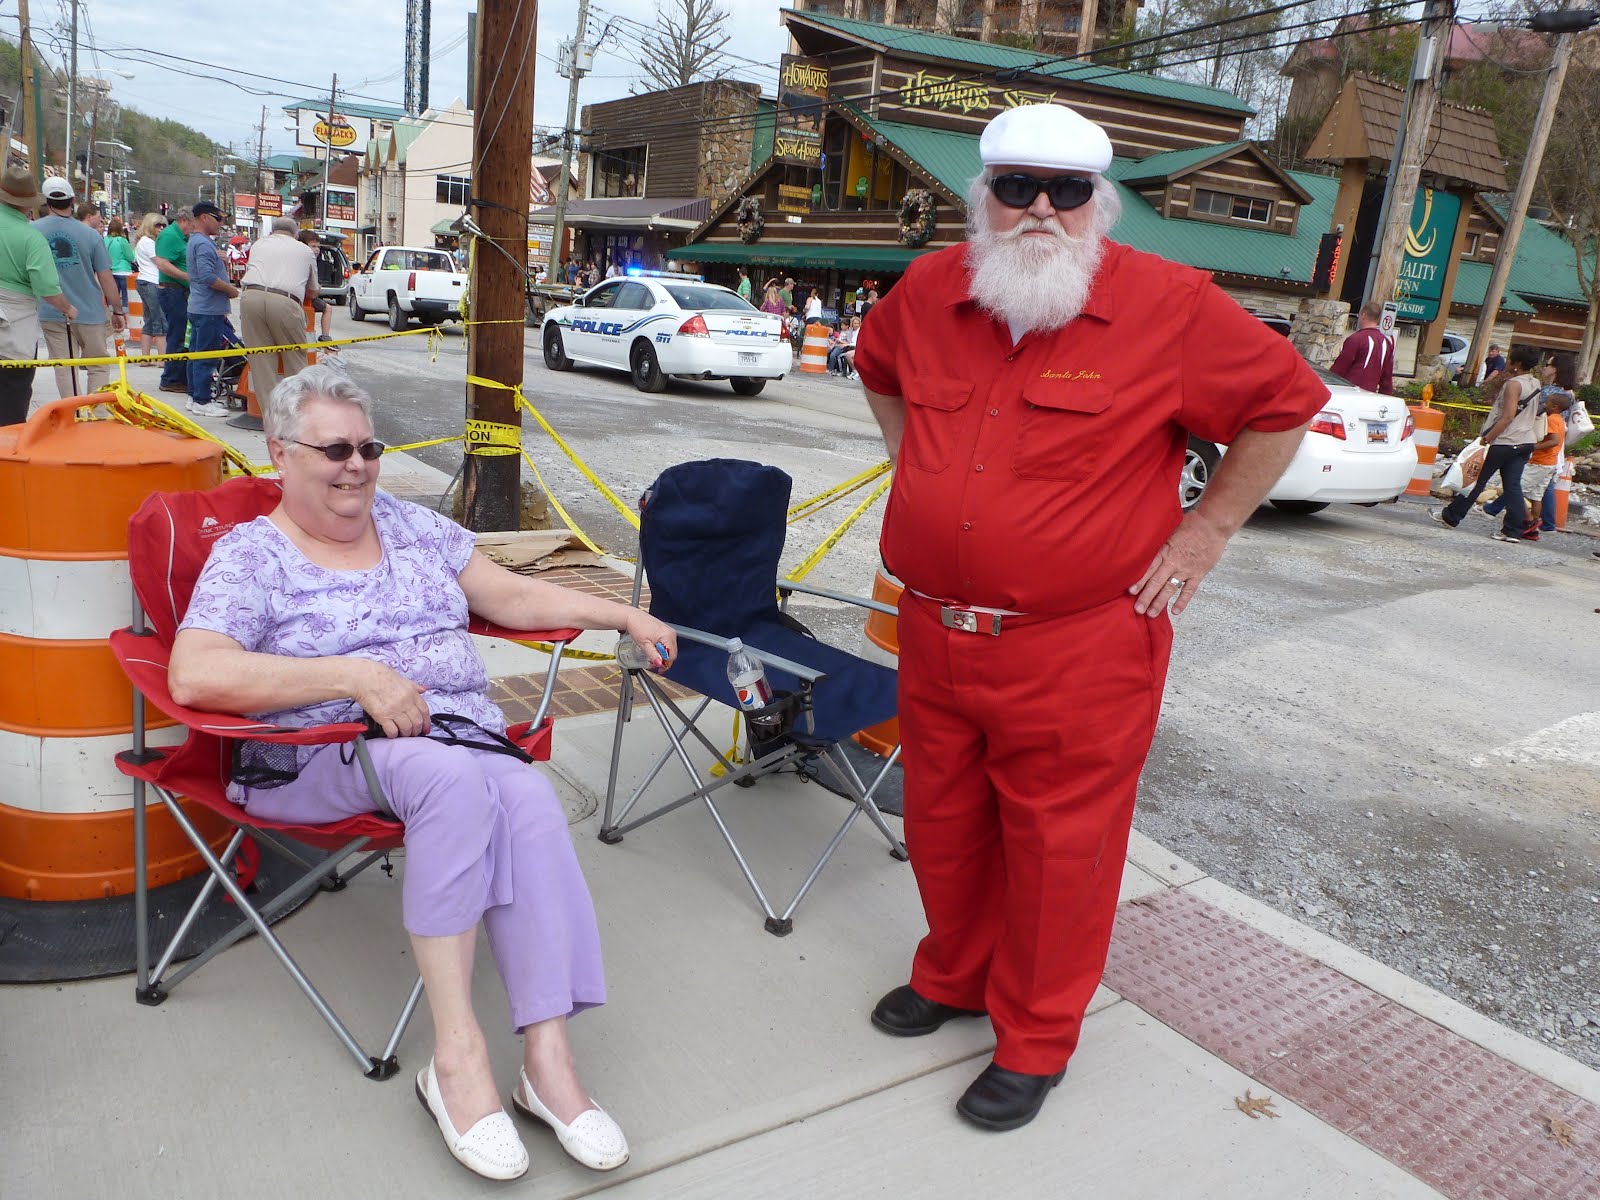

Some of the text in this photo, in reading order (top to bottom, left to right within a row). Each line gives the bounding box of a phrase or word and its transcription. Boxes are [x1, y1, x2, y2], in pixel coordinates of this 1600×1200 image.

[782, 61, 829, 91] HOWARDS
[901, 68, 990, 115] HOWARDS
[258, 192, 281, 202] Summit
[259, 199, 280, 208] Manor
[1400, 260, 1438, 281] UALITY
[570, 319, 624, 337] POLICE
[725, 329, 768, 338] POLICE
[655, 335, 671, 344] 911
[1040, 369, 1073, 379] Santa
